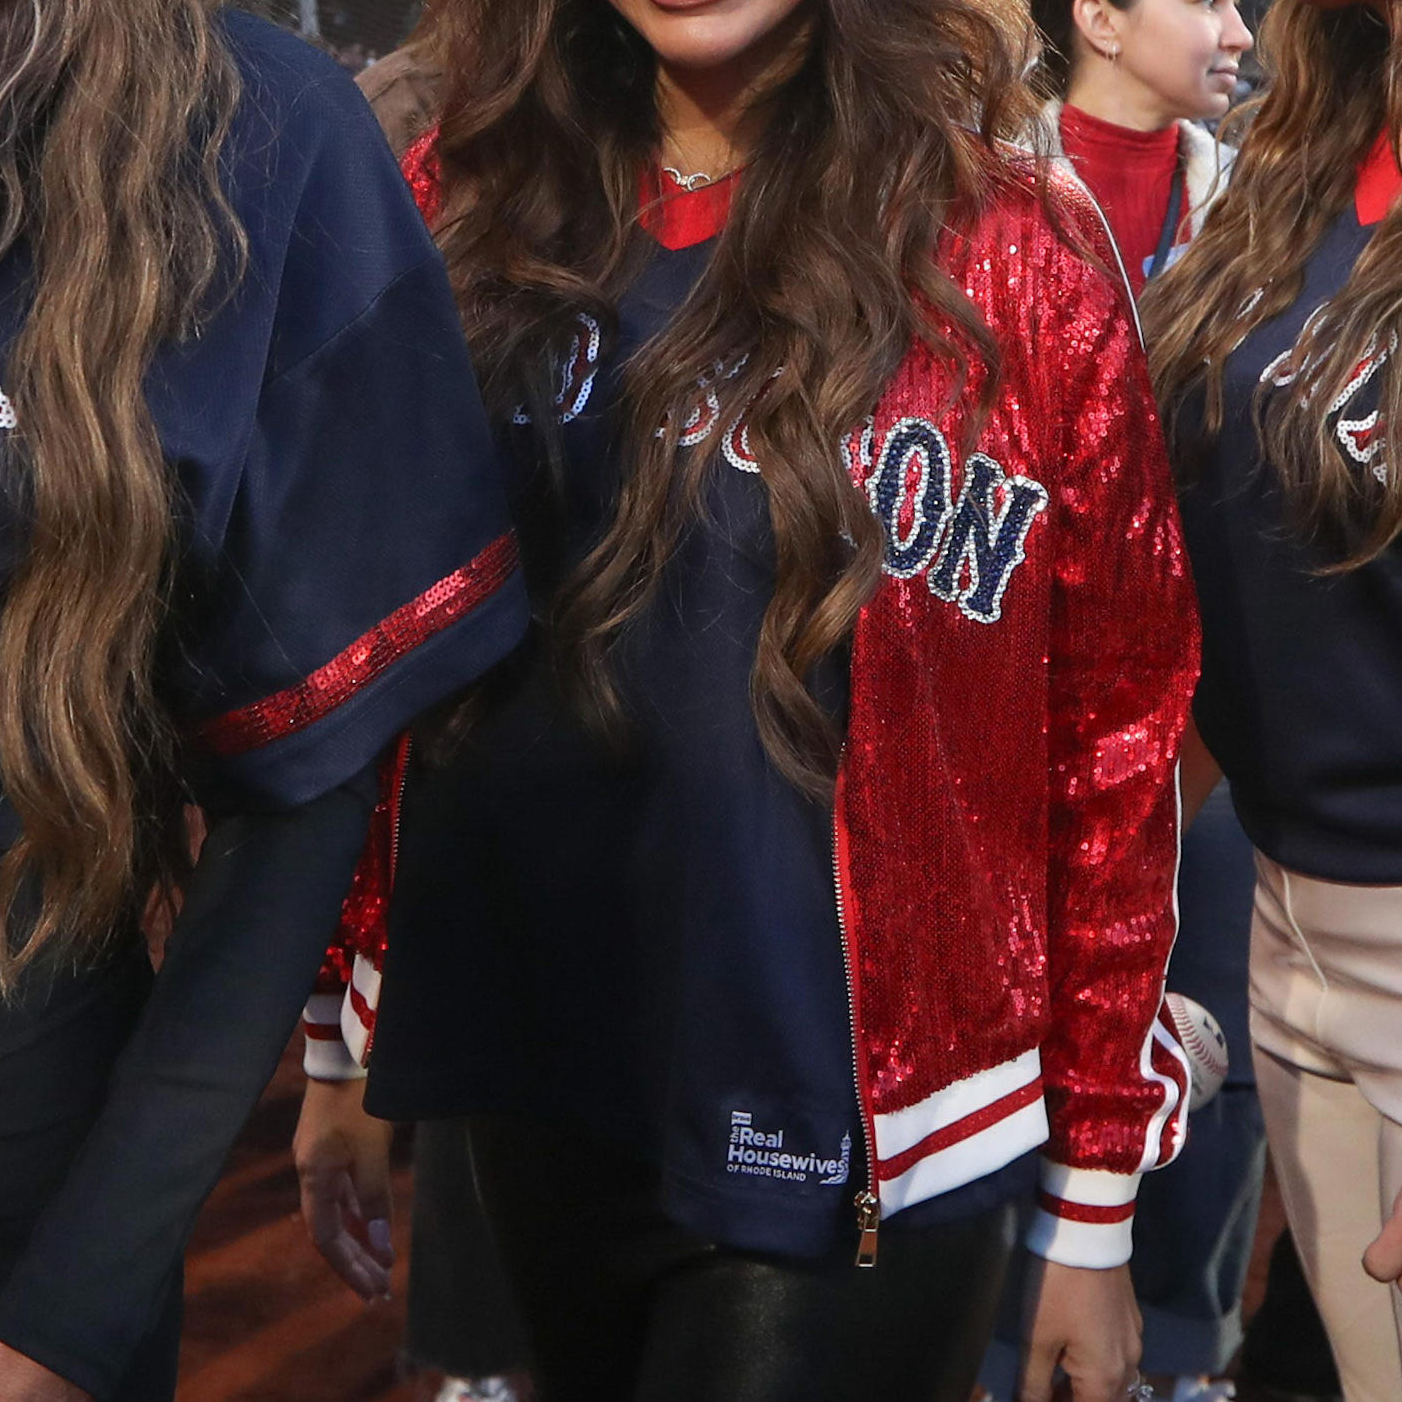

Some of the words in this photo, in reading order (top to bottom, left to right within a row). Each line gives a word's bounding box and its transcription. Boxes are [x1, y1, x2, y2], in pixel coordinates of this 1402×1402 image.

[740, 1126, 784, 1148] Real
[727, 1144, 845, 1175] Housewives
[726, 1164, 739, 1173] OF
[741, 1164, 771, 1176] RHODE
[773, 1169, 807, 1182] ISLAND
